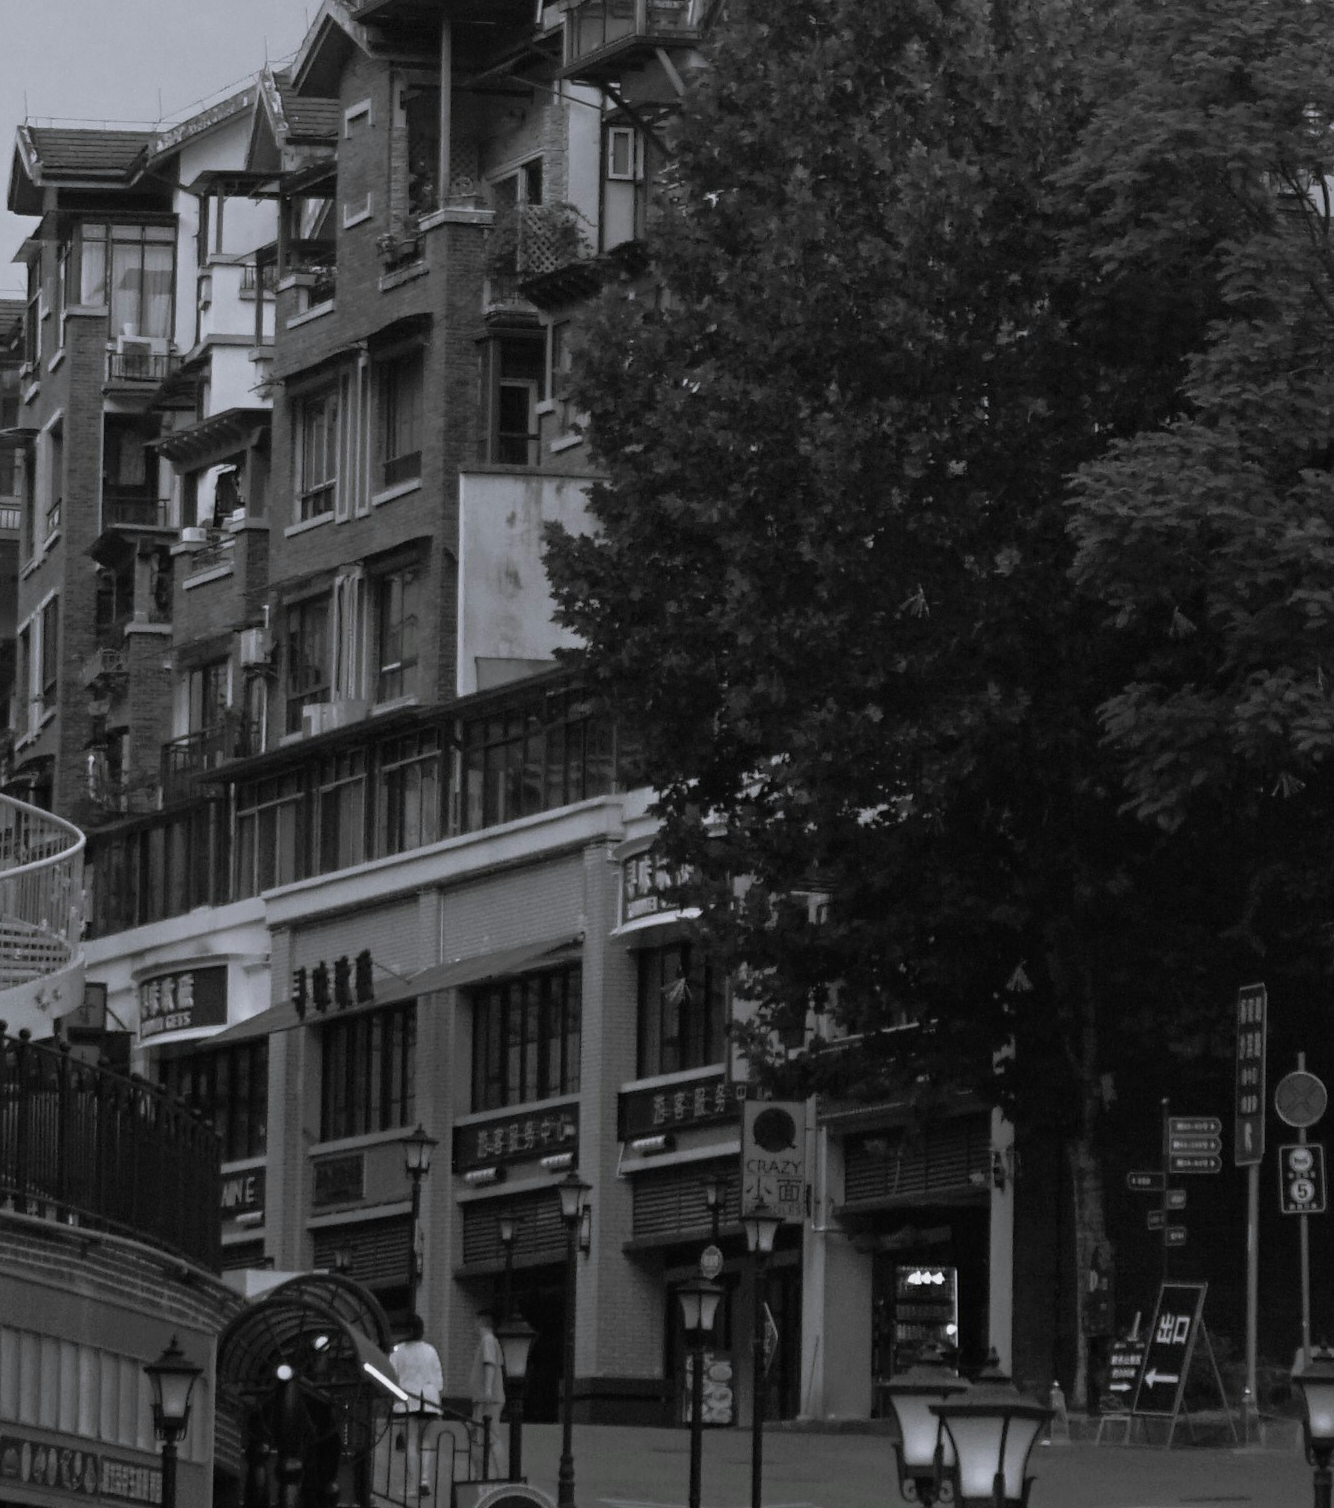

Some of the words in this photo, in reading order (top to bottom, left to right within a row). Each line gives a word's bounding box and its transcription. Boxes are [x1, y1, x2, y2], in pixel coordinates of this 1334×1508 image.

[746, 1159, 802, 1175] CRAZY
[1297, 1183, 1309, 1199] 5
[1155, 1312, 1191, 1344] 出口
